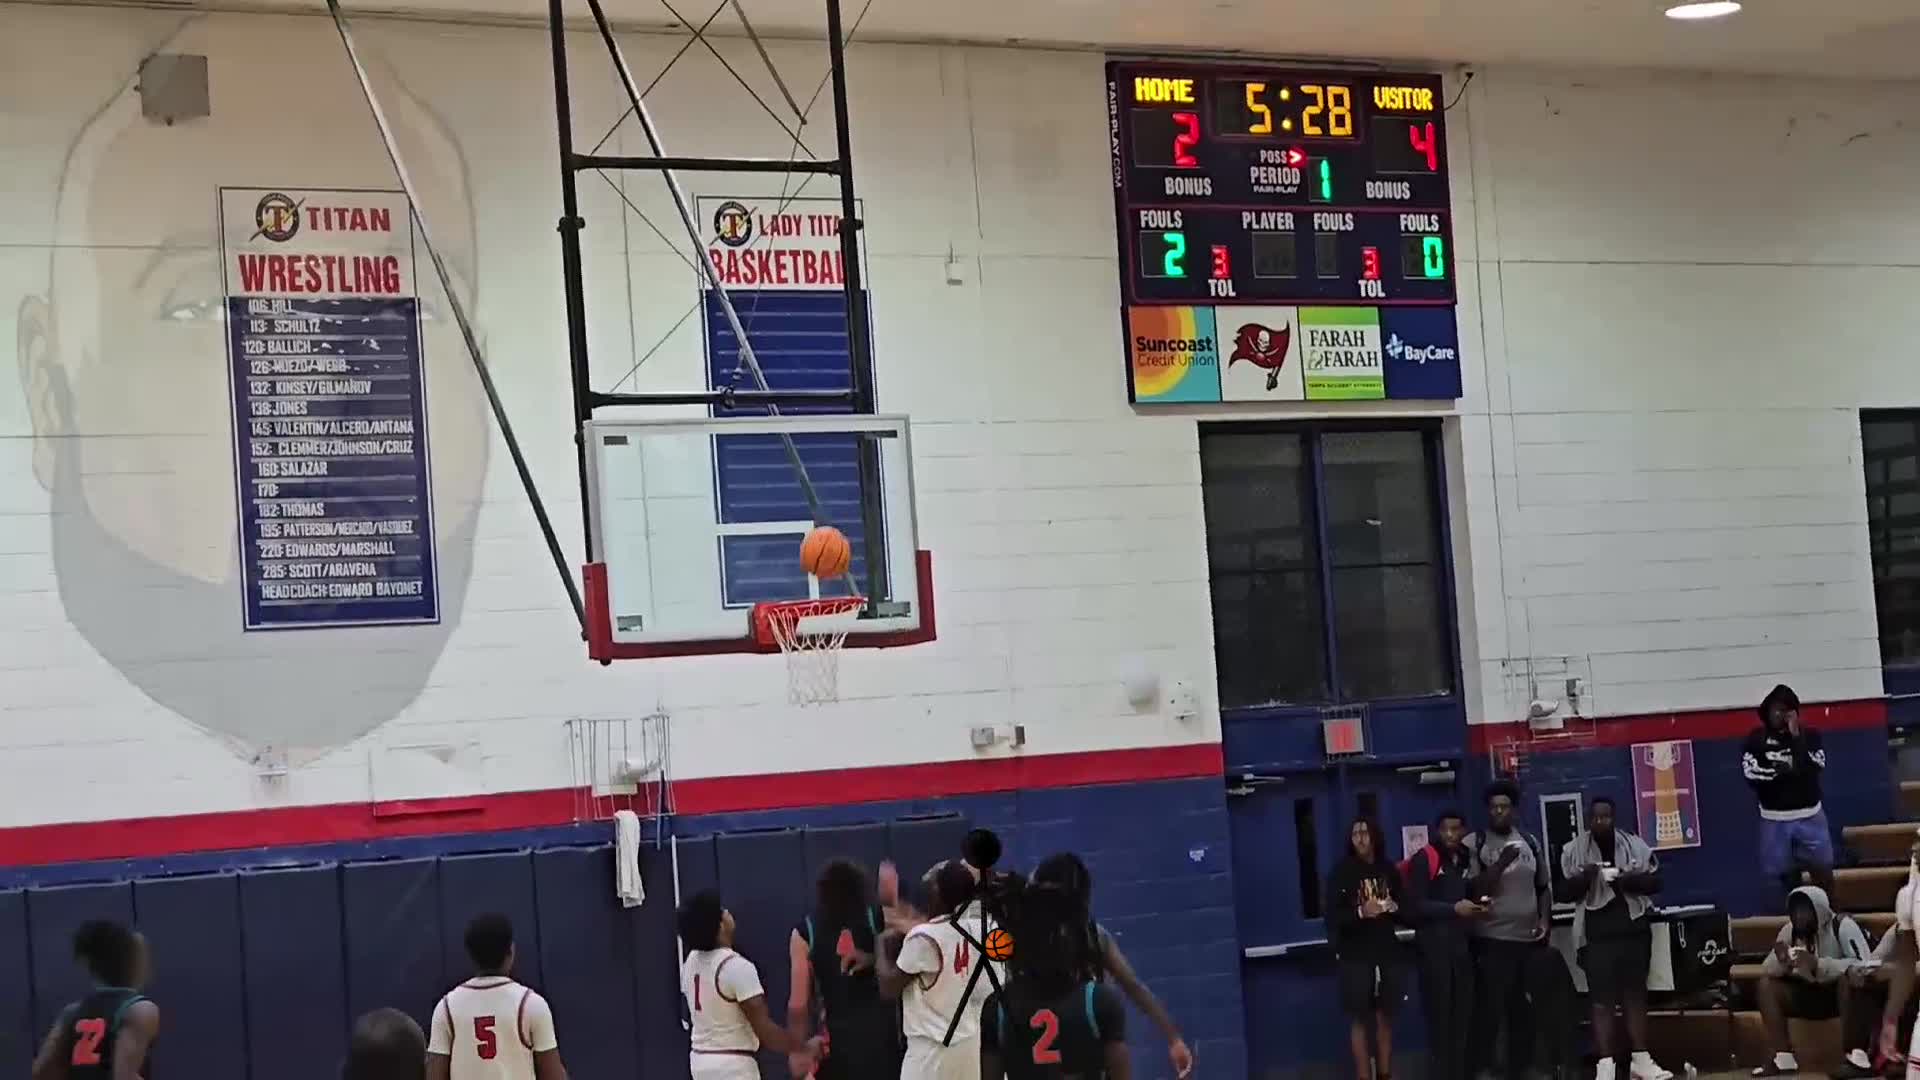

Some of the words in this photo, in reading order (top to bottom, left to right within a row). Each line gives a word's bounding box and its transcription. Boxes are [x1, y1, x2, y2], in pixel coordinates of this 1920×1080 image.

[1135, 77, 1195, 102] HOME
[1373, 87, 1433, 111] VISITOR
[1245, 83, 1352, 136] 5:28
[1172, 112, 1201, 167] 2
[1409, 121, 1437, 172] 4
[1260, 149, 1287, 164] POSS
[1250, 166, 1300, 185] PERIOD
[1321, 159, 1331, 199] 1
[1165, 177, 1212, 196] BONUS
[1366, 181, 1411, 199] BONUS
[305, 207, 391, 232] TITAN
[759, 214, 802, 237] LADY
[807, 215, 843, 236] TITA
[1139, 211, 1183, 229] FOULS
[1242, 211, 1295, 231] PLAYER
[1313, 213, 1354, 231] FOULS
[1400, 214, 1440, 232] FOULS
[1163, 232, 1186, 277] 2
[1211, 246, 1231, 278] 3
[1362, 248, 1381, 279] 3
[1423, 236, 1445, 278] 0
[238, 254, 400, 293] WRESTLING
[1208, 279, 1236, 297] TOL
[1358, 280, 1386, 298] TOL
[250, 319, 268, 333] 113:
[274, 319, 320, 333] SCHULTZ
[267, 340, 311, 354] BALLICH
[1136, 336, 1213, 352] Suncoast
[1310, 330, 1365, 347] FARAH
[1138, 352, 1174, 366] Credit
[1179, 353, 1214, 366] Union
[1324, 350, 1378, 367] FARAH
[1404, 345, 1454, 364] BayCare
[250, 381, 272, 395] 132:
[273, 400, 308, 415] JONES
[252, 422, 272, 436] 145:
[252, 441, 272, 456] 152:
[258, 462, 280, 476] 160:
[281, 460, 328, 476] SALAZAR
[258, 483, 279, 497] 170:
[258, 503, 281, 517] 182:
[282, 502, 325, 517] THOMAS
[260, 523, 282, 537] 195:
[260, 544, 284, 558] 220:
[286, 541, 395, 558] EDWARDS/MARSHALL
[263, 565, 287, 579] 285:
[289, 562, 377, 578] SCOTT/ARAVENA
[376, 581, 423, 597] BAYONET
[693, 974, 702, 1010] 1
[473, 1016, 496, 1059] 5
[1030, 1009, 1061, 1063] 2
